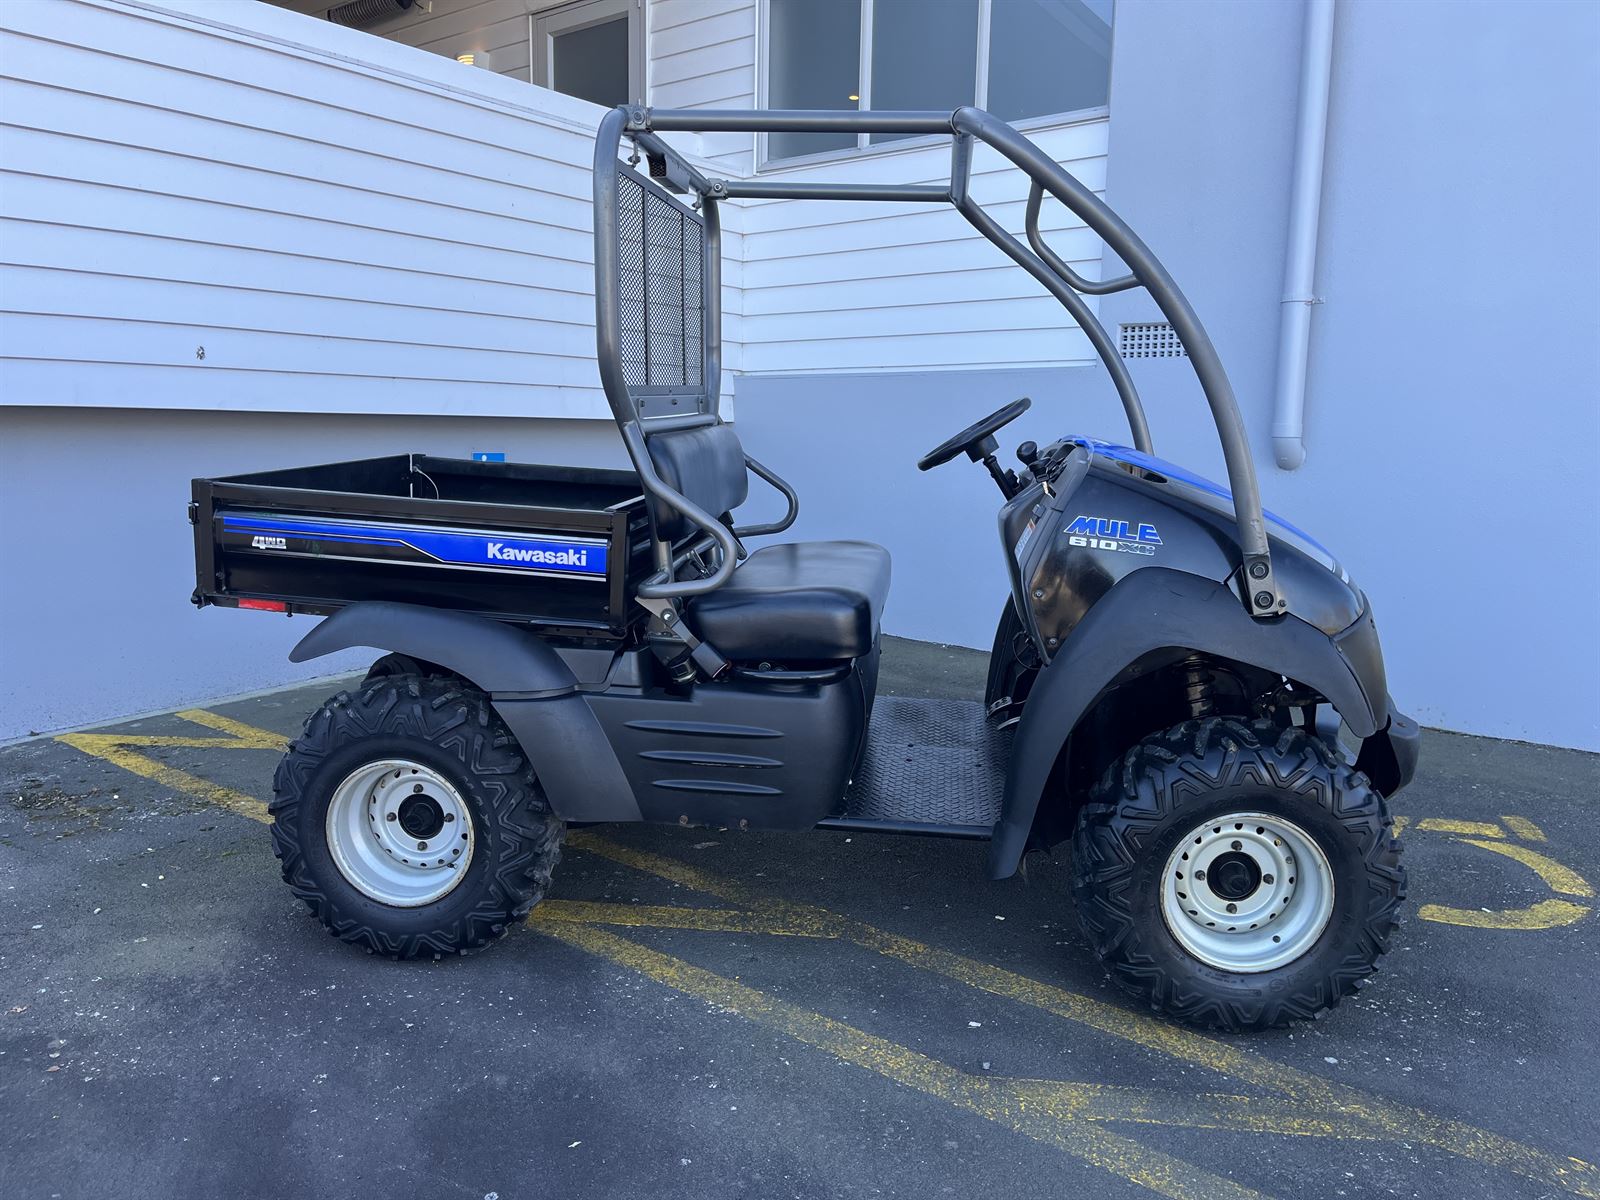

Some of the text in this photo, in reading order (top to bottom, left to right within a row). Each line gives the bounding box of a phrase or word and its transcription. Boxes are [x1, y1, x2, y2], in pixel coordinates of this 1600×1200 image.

[1063, 515, 1163, 545] MULE
[252, 536, 286, 549] 4WD
[1069, 536, 1155, 556] 610XC
[487, 542, 587, 566] Kawasaki
